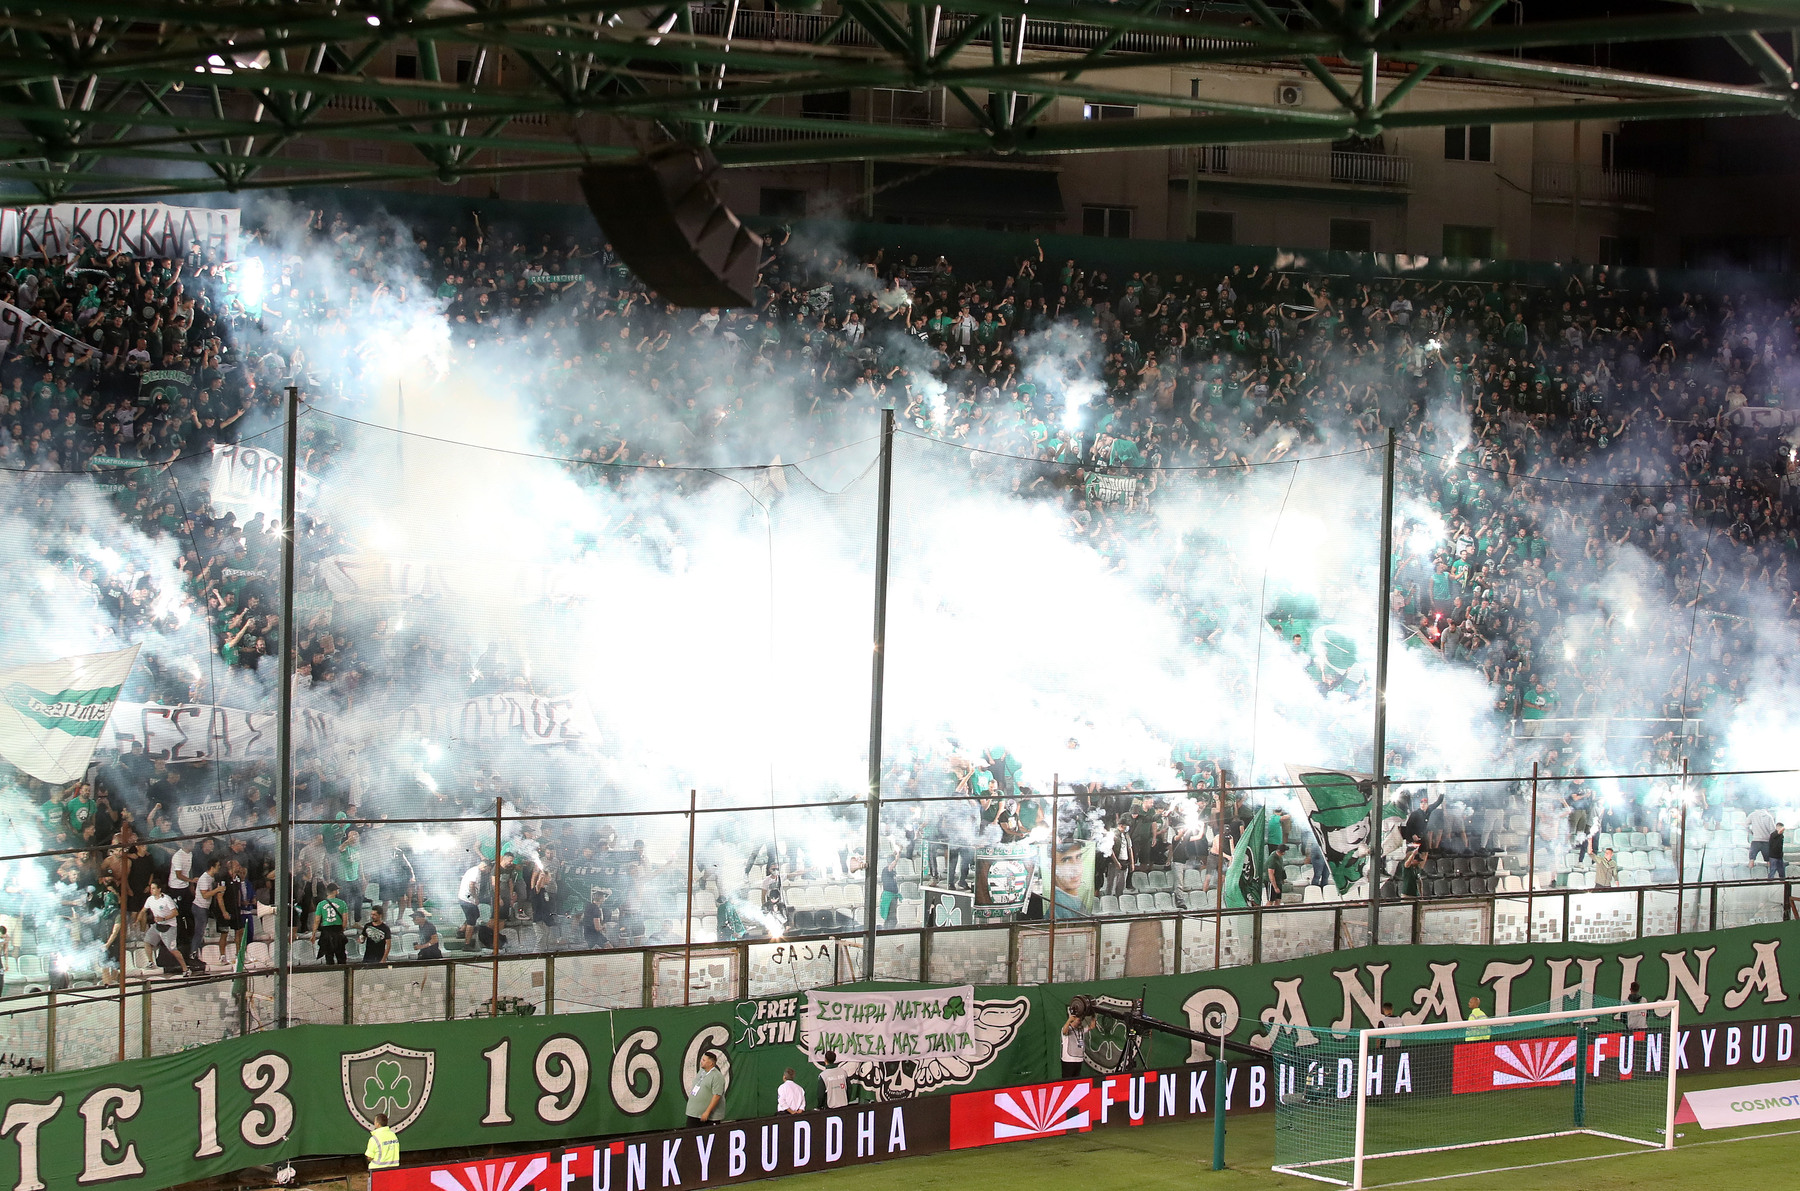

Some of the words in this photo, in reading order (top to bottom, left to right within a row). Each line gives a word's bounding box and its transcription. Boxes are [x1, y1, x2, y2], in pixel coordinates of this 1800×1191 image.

[757, 997, 798, 1021] FREE
[816, 1000, 887, 1024] ΣΩΤΗΡΗ
[892, 999, 941, 1022] ΜΑΓΚΑ
[755, 1020, 797, 1046] STN
[891, 1031, 920, 1056] ΜΑΣ
[924, 1031, 973, 1055] ΠΑΝΤΑ
[1593, 1023, 1793, 1078] FUNKYBUD
[192, 1053, 294, 1159] 13
[480, 1021, 734, 1128] 1966
[1730, 1094, 1800, 1113] COSMOT
[560, 1106, 908, 1191] FUNKYBUDDHA
